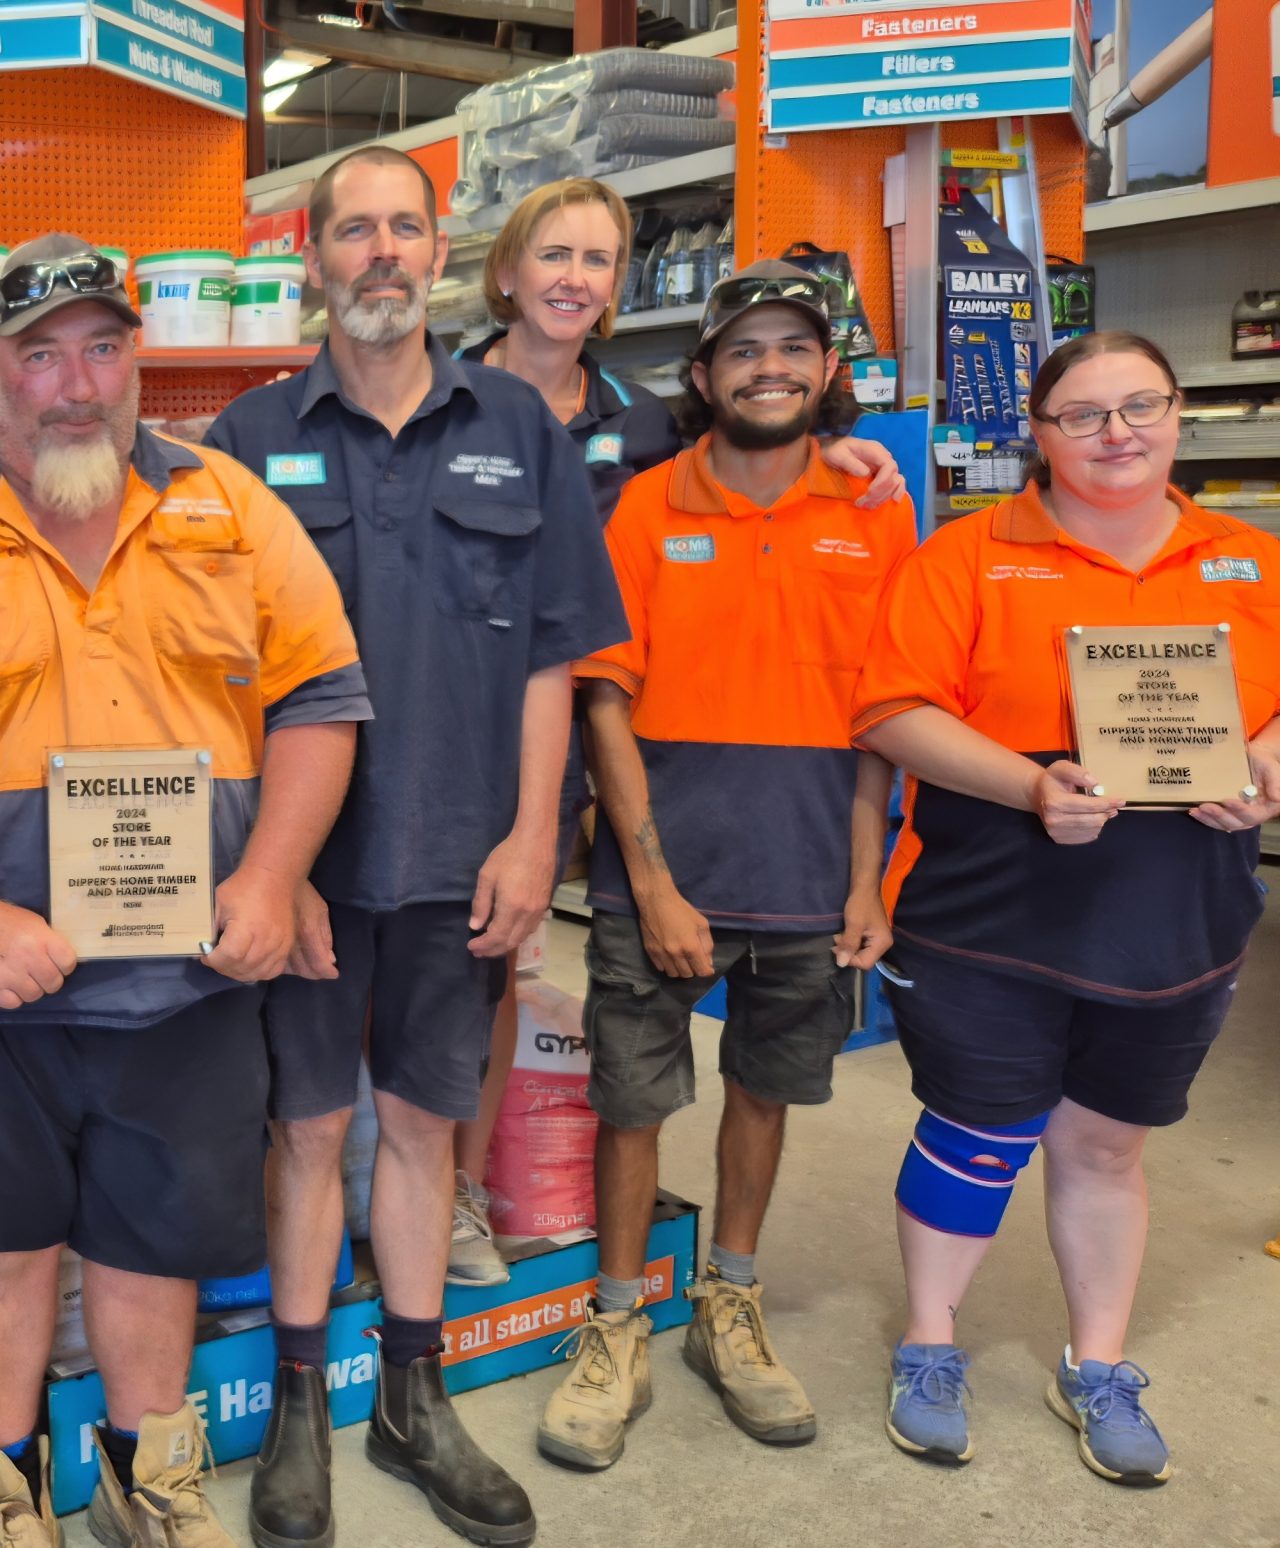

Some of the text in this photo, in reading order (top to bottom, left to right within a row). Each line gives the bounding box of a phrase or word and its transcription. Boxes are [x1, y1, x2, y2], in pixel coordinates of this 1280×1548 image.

[189, 16, 214, 47] Rod
[861, 14, 977, 38] Fasteners
[129, 41, 223, 98] Nuts & Washers
[882, 54, 955, 76] Fillers
[862, 92, 979, 116] Fasteners
[951, 271, 1028, 294] BAILEY
[1086, 643, 1217, 660] EXCELLENCE
[1140, 670, 1171, 678] 2024
[1137, 681, 1177, 690] STORE
[1118, 692, 1200, 703] OF THE YEAR
[1148, 766, 1191, 778] HOME
[66, 776, 196, 798] EXCELLENCE
[116, 808, 147, 819] 2024
[112, 822, 151, 833] STORE
[92, 836, 172, 848] OF THE YEAR
[68, 875, 197, 888] DIPPER'S HOME TIMBER
[87, 886, 179, 897] AND HARDWARE
[534, 1032, 590, 1056] GYPR
[460, 1319, 491, 1351] all
[496, 1303, 565, 1340] starts
